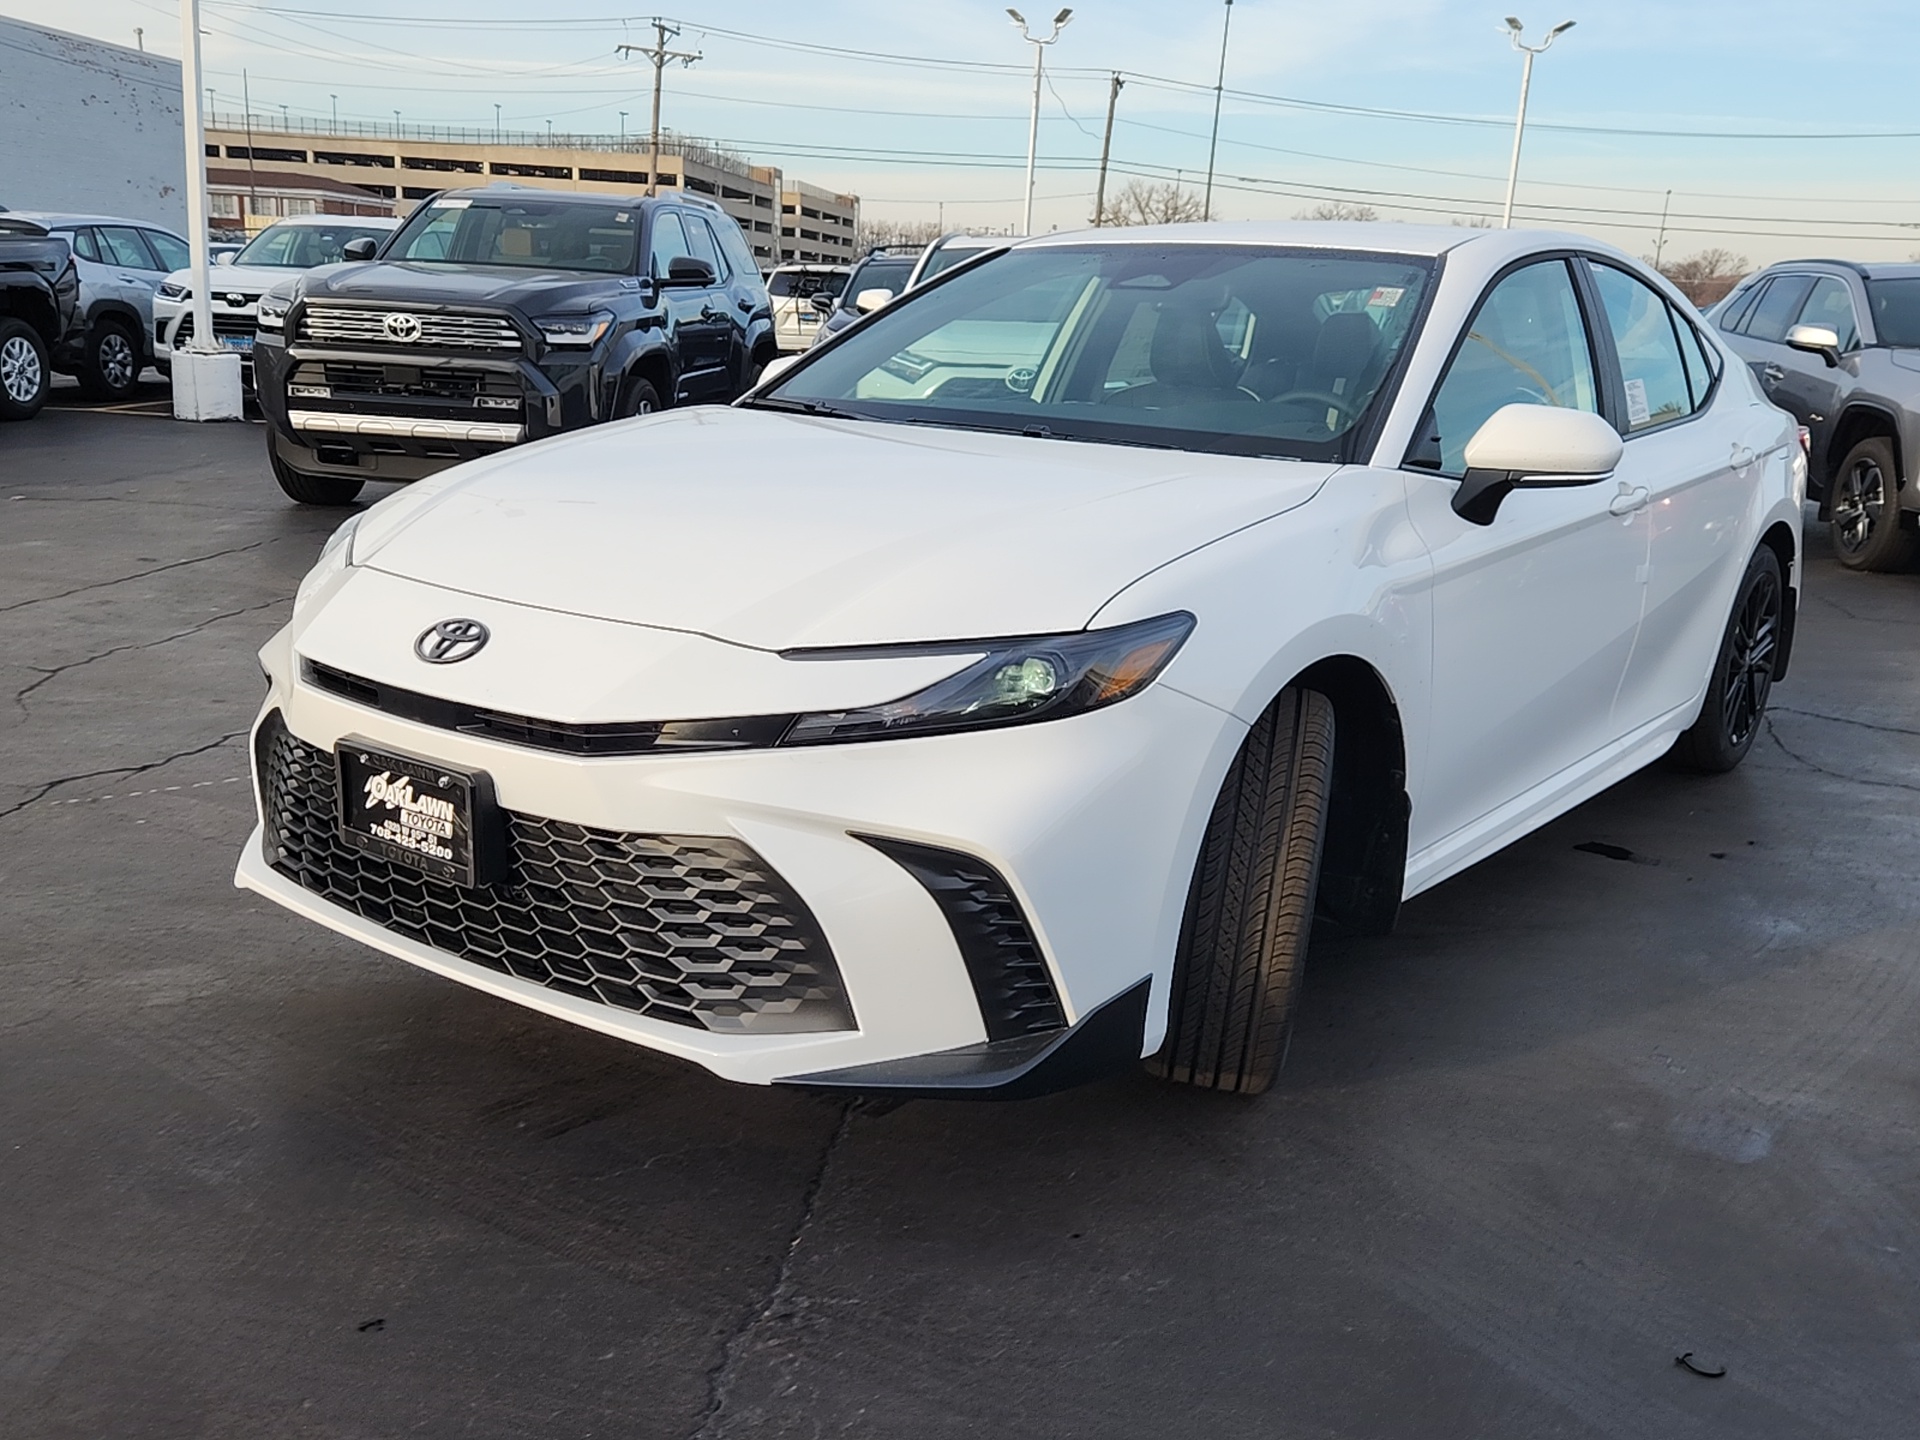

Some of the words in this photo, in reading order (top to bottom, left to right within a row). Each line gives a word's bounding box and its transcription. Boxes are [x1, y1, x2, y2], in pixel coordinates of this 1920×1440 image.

[372, 754, 398, 772] OAK
[399, 761, 438, 782] LAWN
[405, 812, 446, 834] TOYOTA
[369, 822, 453, 860] 708-423-5200
[380, 842, 428, 871] TOYOTA
